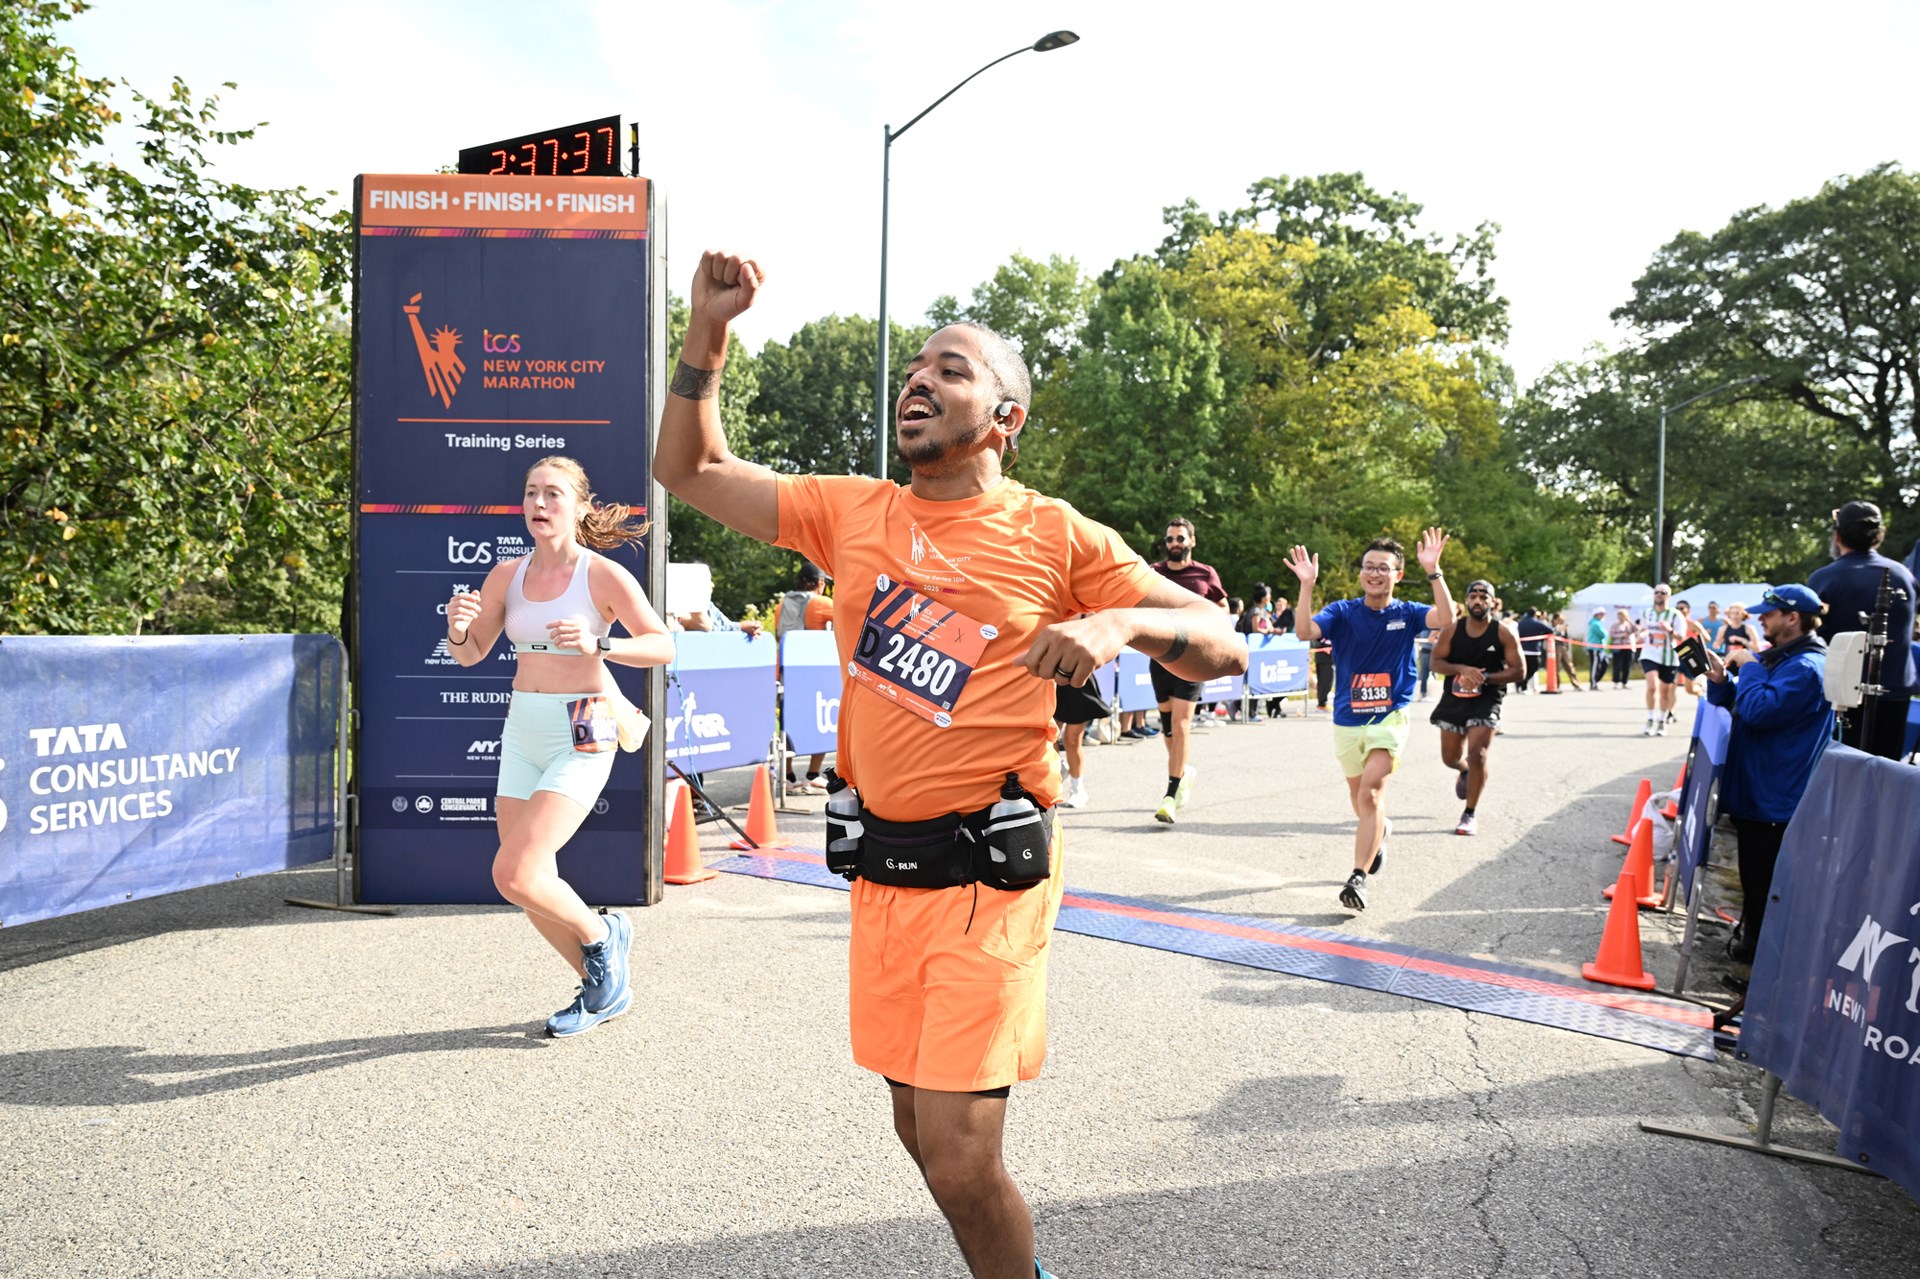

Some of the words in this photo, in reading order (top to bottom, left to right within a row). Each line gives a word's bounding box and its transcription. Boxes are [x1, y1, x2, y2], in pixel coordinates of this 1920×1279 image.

[370, 190, 448, 210] FINISH
[463, 192, 541, 211] FINISH
[557, 193, 635, 214] FINISH
[483, 329, 521, 353] tcs
[483, 360, 522, 373] NEW
[524, 360, 568, 373] YORK
[570, 360, 605, 374] CITY
[483, 376, 575, 389] MARATHON
[445, 434, 512, 450] Training
[514, 434, 565, 449] Series
[496, 536, 524, 545] TATA
[448, 536, 492, 564] tcs
[905, 567, 931, 580] Training
[860, 626, 880, 659] D
[878, 633, 957, 696] 2480
[441, 692, 468, 704] THE
[1361, 687, 1387, 701] 3138
[29, 722, 128, 757] TATA
[575, 724, 589, 742] D
[29, 747, 241, 795] CONSULTANCY
[29, 790, 173, 835] SERVICES
